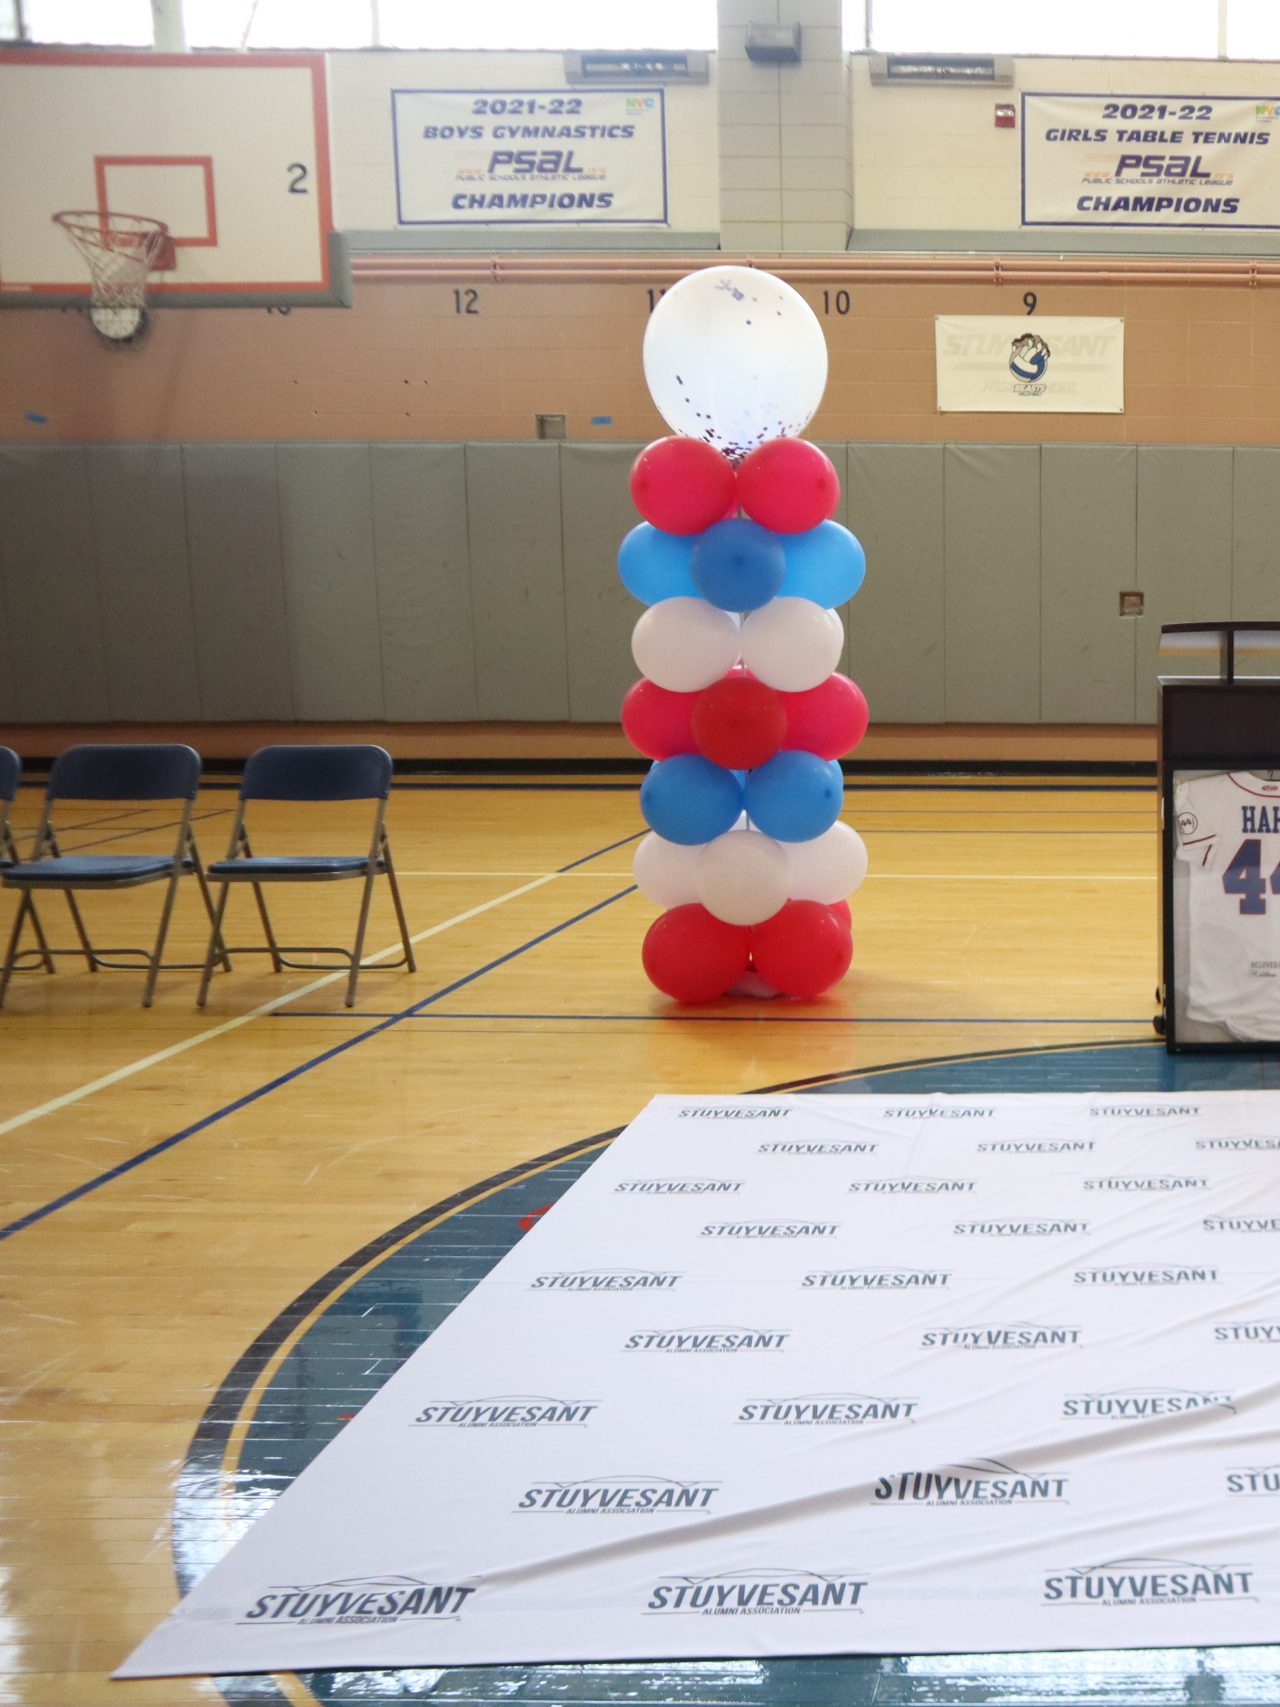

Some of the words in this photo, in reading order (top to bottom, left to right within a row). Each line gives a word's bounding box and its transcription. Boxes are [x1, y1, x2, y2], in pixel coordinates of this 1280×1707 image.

[472, 99, 583, 115] 2021-22
[1102, 104, 1213, 120] 2021-22
[423, 126, 485, 139] BOYS
[492, 125, 635, 138] GYMNASTICS
[1045, 129, 1107, 142] GIRLS
[1116, 130, 1183, 144] TABLE
[1192, 131, 1270, 145] TENNIS
[287, 162, 308, 194] 2
[452, 193, 614, 209] CHAMPIONS
[1076, 195, 1240, 214] CHAMPIONS
[453, 289, 479, 315] 12
[823, 290, 850, 315] 10
[1023, 291, 1038, 315] 9
[678, 1108, 791, 1118] STUYVESANT
[1090, 1106, 1199, 1116] STUYVESANT
[758, 1143, 877, 1153] STUYVESANT
[977, 1141, 1096, 1151] STUYVESANT
[614, 1182, 745, 1192] STUYVESANT
[849, 1181, 976, 1192] STUYVESANT
[1083, 1178, 1207, 1190] STUYVESANT
[701, 1224, 841, 1236] STUYVESANT
[953, 1223, 1090, 1235] STUYVESANT
[531, 1275, 683, 1289] STUYVESANT
[802, 1273, 952, 1287] STUYVESANT
[1074, 1269, 1220, 1283] STUYVESANT
[625, 1334, 789, 1349] STUYVESANT
[921, 1329, 1082, 1347] STUYVESANT
[416, 1406, 597, 1424] STUYVESANT
[739, 1403, 918, 1421] STUYVESANT
[875, 1472, 1069, 1500] STUYVESANT
[519, 1488, 719, 1508] STUYVESANT
[1041, 1573, 1252, 1600] STUYVESANT
[246, 1586, 477, 1618] STUYVESANT
[648, 1582, 867, 1609] STUYVESANT
[1102, 1599, 1137, 1607] ALUMNI
[1138, 1596, 1197, 1605] ASSOCIATION
[702, 1607, 738, 1615] ALUMNI
[740, 1607, 801, 1615] ASSOCIATION
